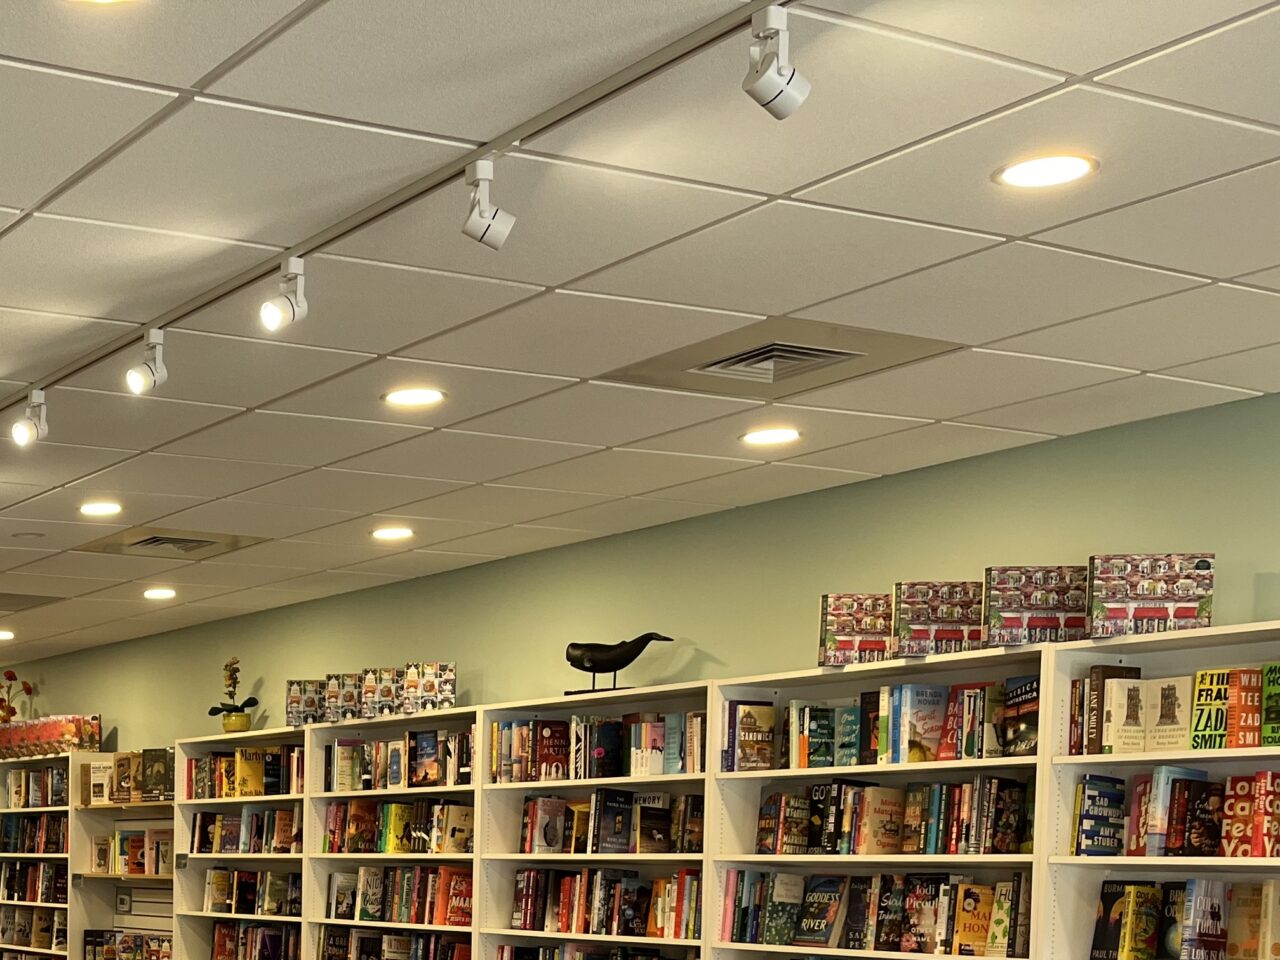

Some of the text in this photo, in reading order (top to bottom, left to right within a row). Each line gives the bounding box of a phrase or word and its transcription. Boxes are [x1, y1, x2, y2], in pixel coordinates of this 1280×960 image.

[1241, 673, 1262, 687] WHI
[1197, 688, 1230, 702] FRAU
[1241, 692, 1260, 706] TEE
[1089, 691, 1098, 739] JANE SMILEY
[1194, 708, 1228, 732] ZADI
[1240, 713, 1260, 726] ZAD
[740, 732, 773, 741] SANDWICH
[1192, 733, 1228, 749] SMIT
[1239, 732, 1259, 745] SMI
[1095, 797, 1108, 806] SAD
[1100, 827, 1114, 836] AMY
[1222, 819, 1253, 836] Fee
[1094, 836, 1118, 847] STUBER
[1221, 839, 1252, 857] Yo
[916, 884, 935, 895] Jodi
[806, 892, 841, 903] GODDESS
[1196, 896, 1219, 911] COLM
[801, 918, 827, 931] RIVER
[1092, 950, 1107, 958] PAUL
[1192, 948, 1208, 960] LONG
